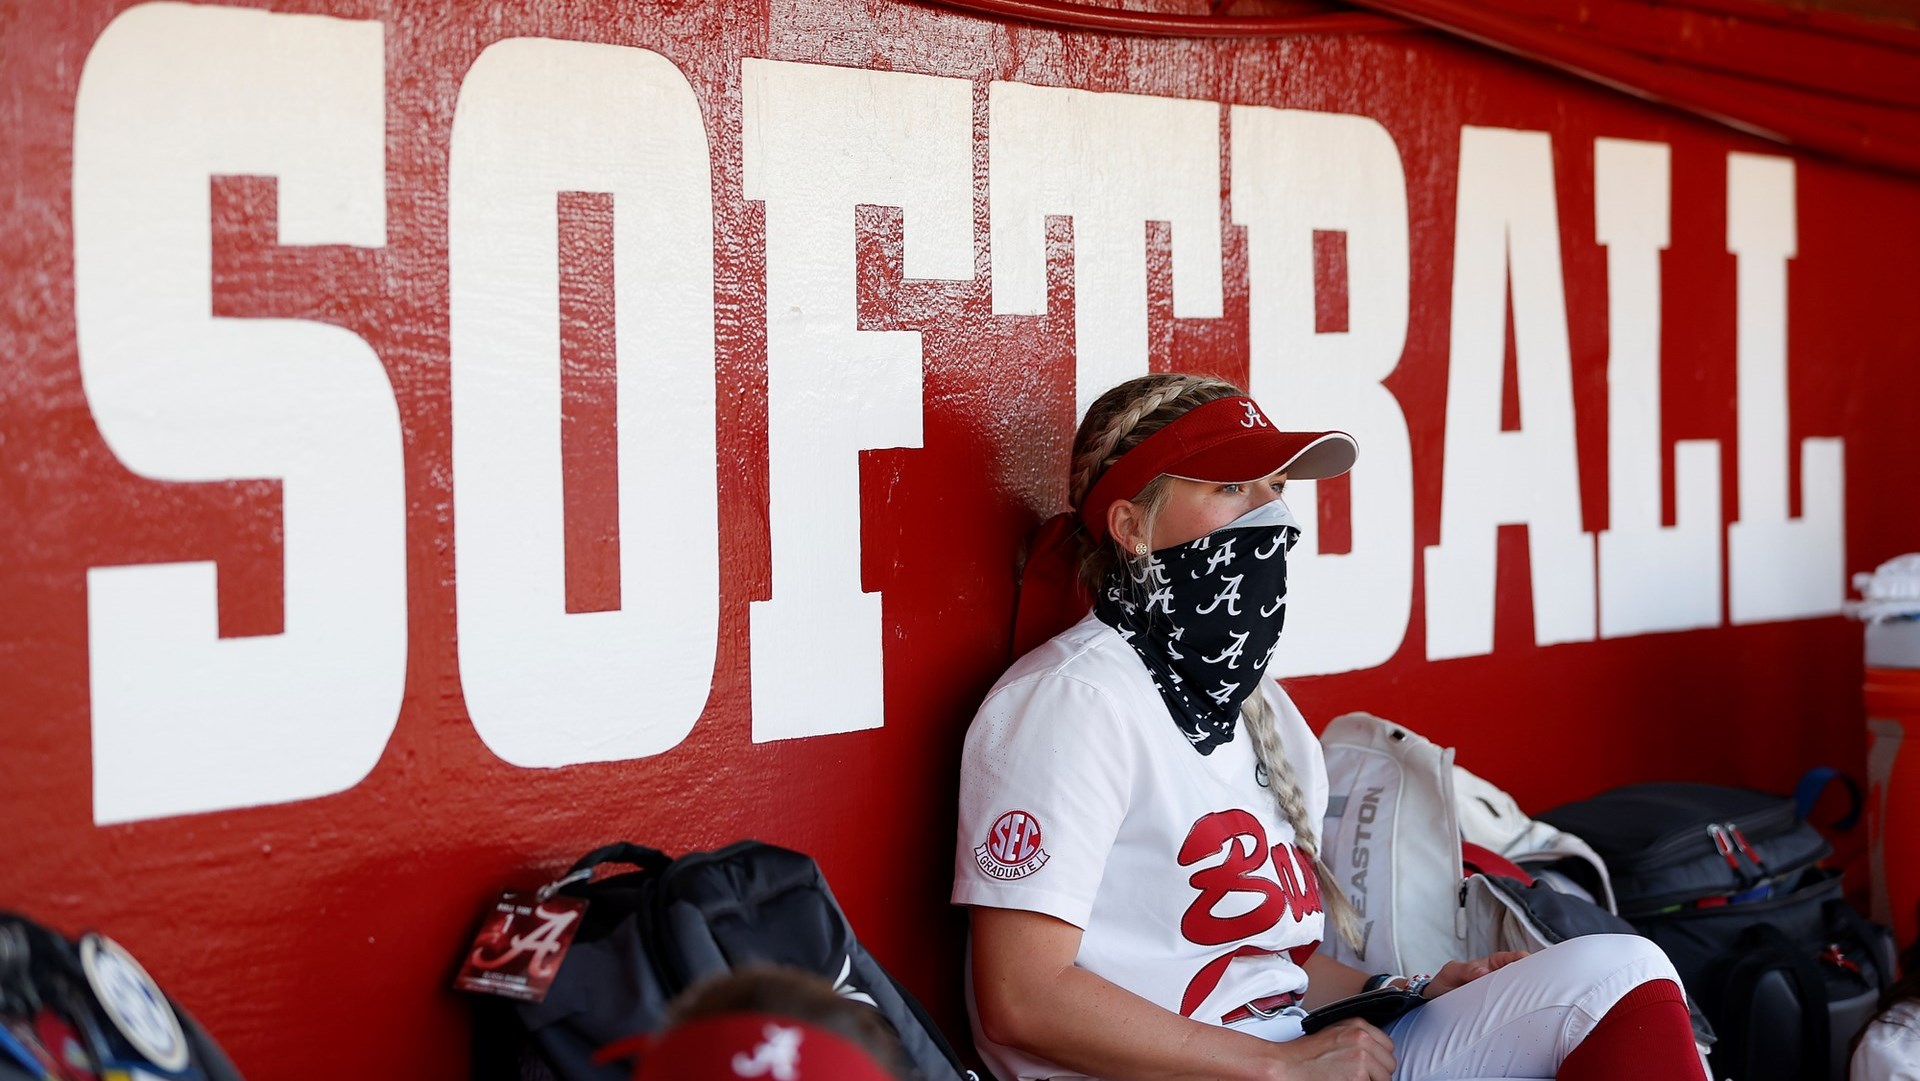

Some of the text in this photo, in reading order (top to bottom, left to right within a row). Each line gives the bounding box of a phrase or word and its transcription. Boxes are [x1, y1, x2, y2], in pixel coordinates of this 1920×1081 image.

[74, 2, 1846, 826] SOFTBALL
[1240, 401, 1267, 428] A
[1196, 573, 1244, 616] A
[1202, 630, 1250, 669] A
[991, 813, 1039, 861] SEC
[1351, 786, 1385, 918] EASTON
[979, 855, 1037, 878] GRADUATE
